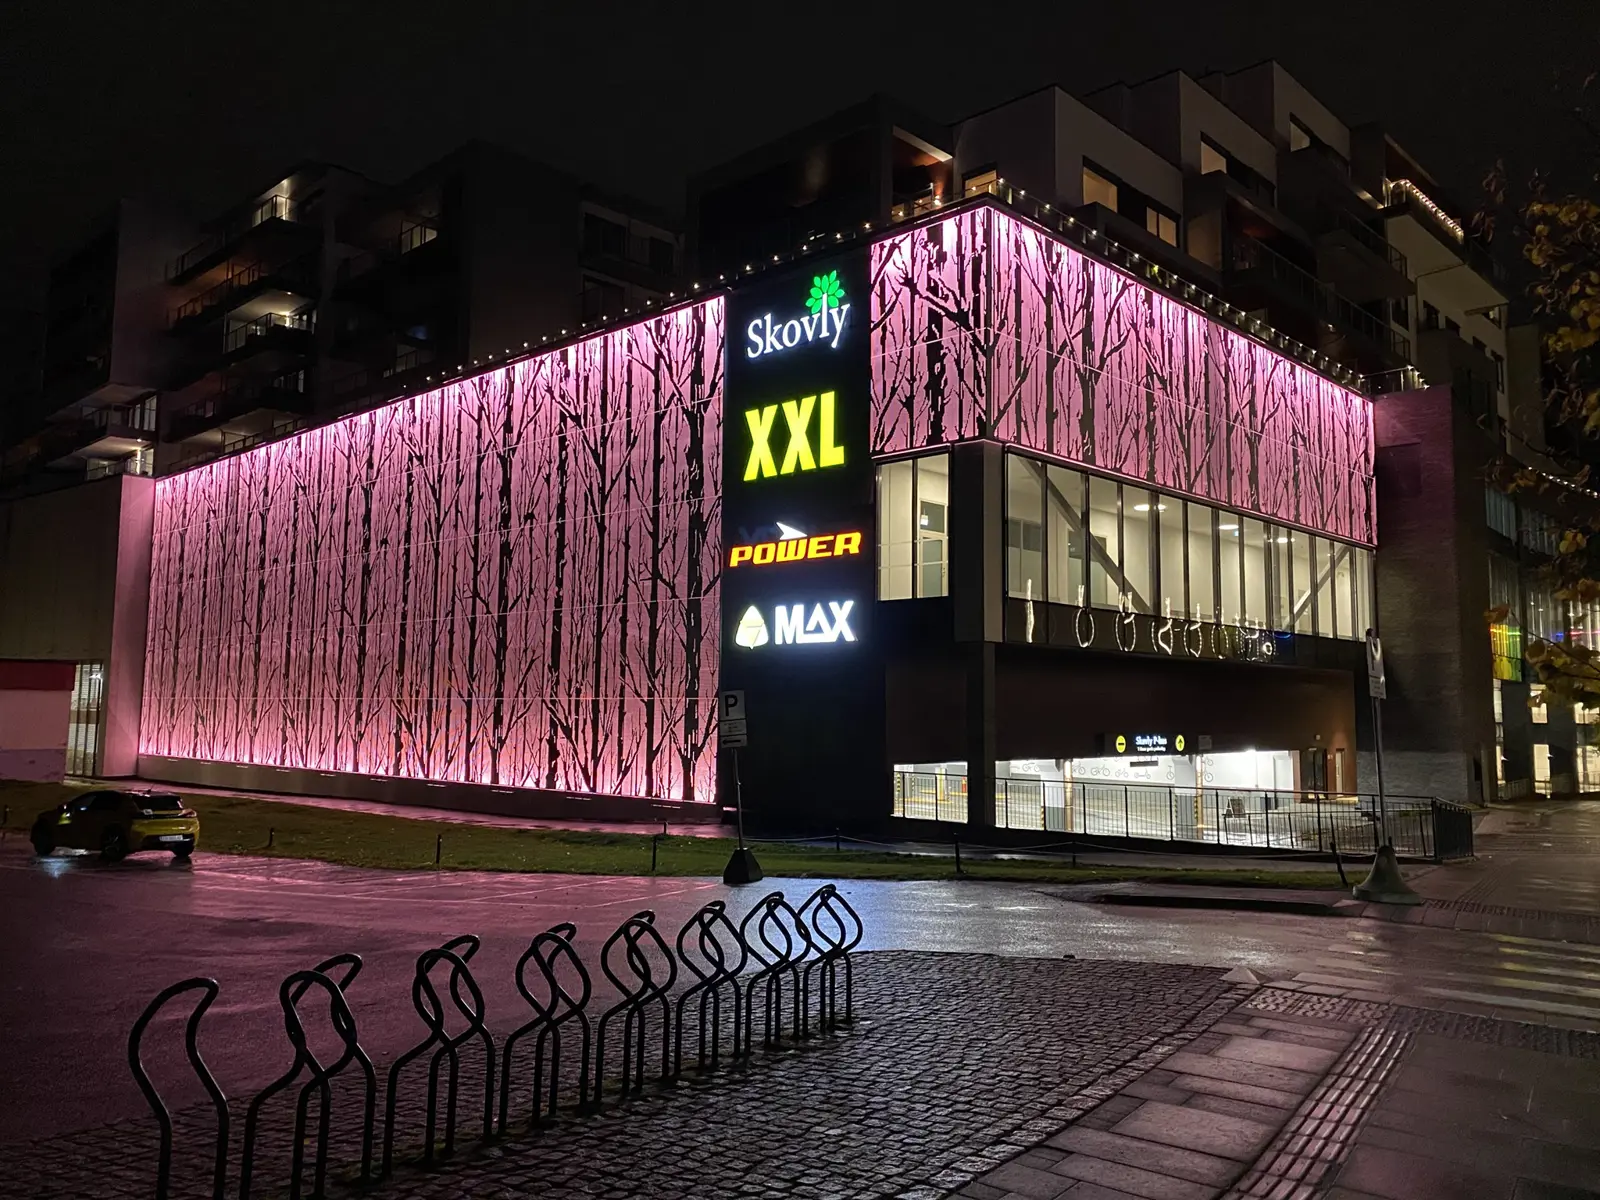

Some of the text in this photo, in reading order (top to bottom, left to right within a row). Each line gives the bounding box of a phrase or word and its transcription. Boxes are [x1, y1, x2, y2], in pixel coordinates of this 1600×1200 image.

[746, 292, 851, 360] Skovly
[743, 390, 846, 482] XXL
[728, 530, 863, 568] POWER
[774, 600, 857, 646] MAX
[724, 694, 738, 717] P
